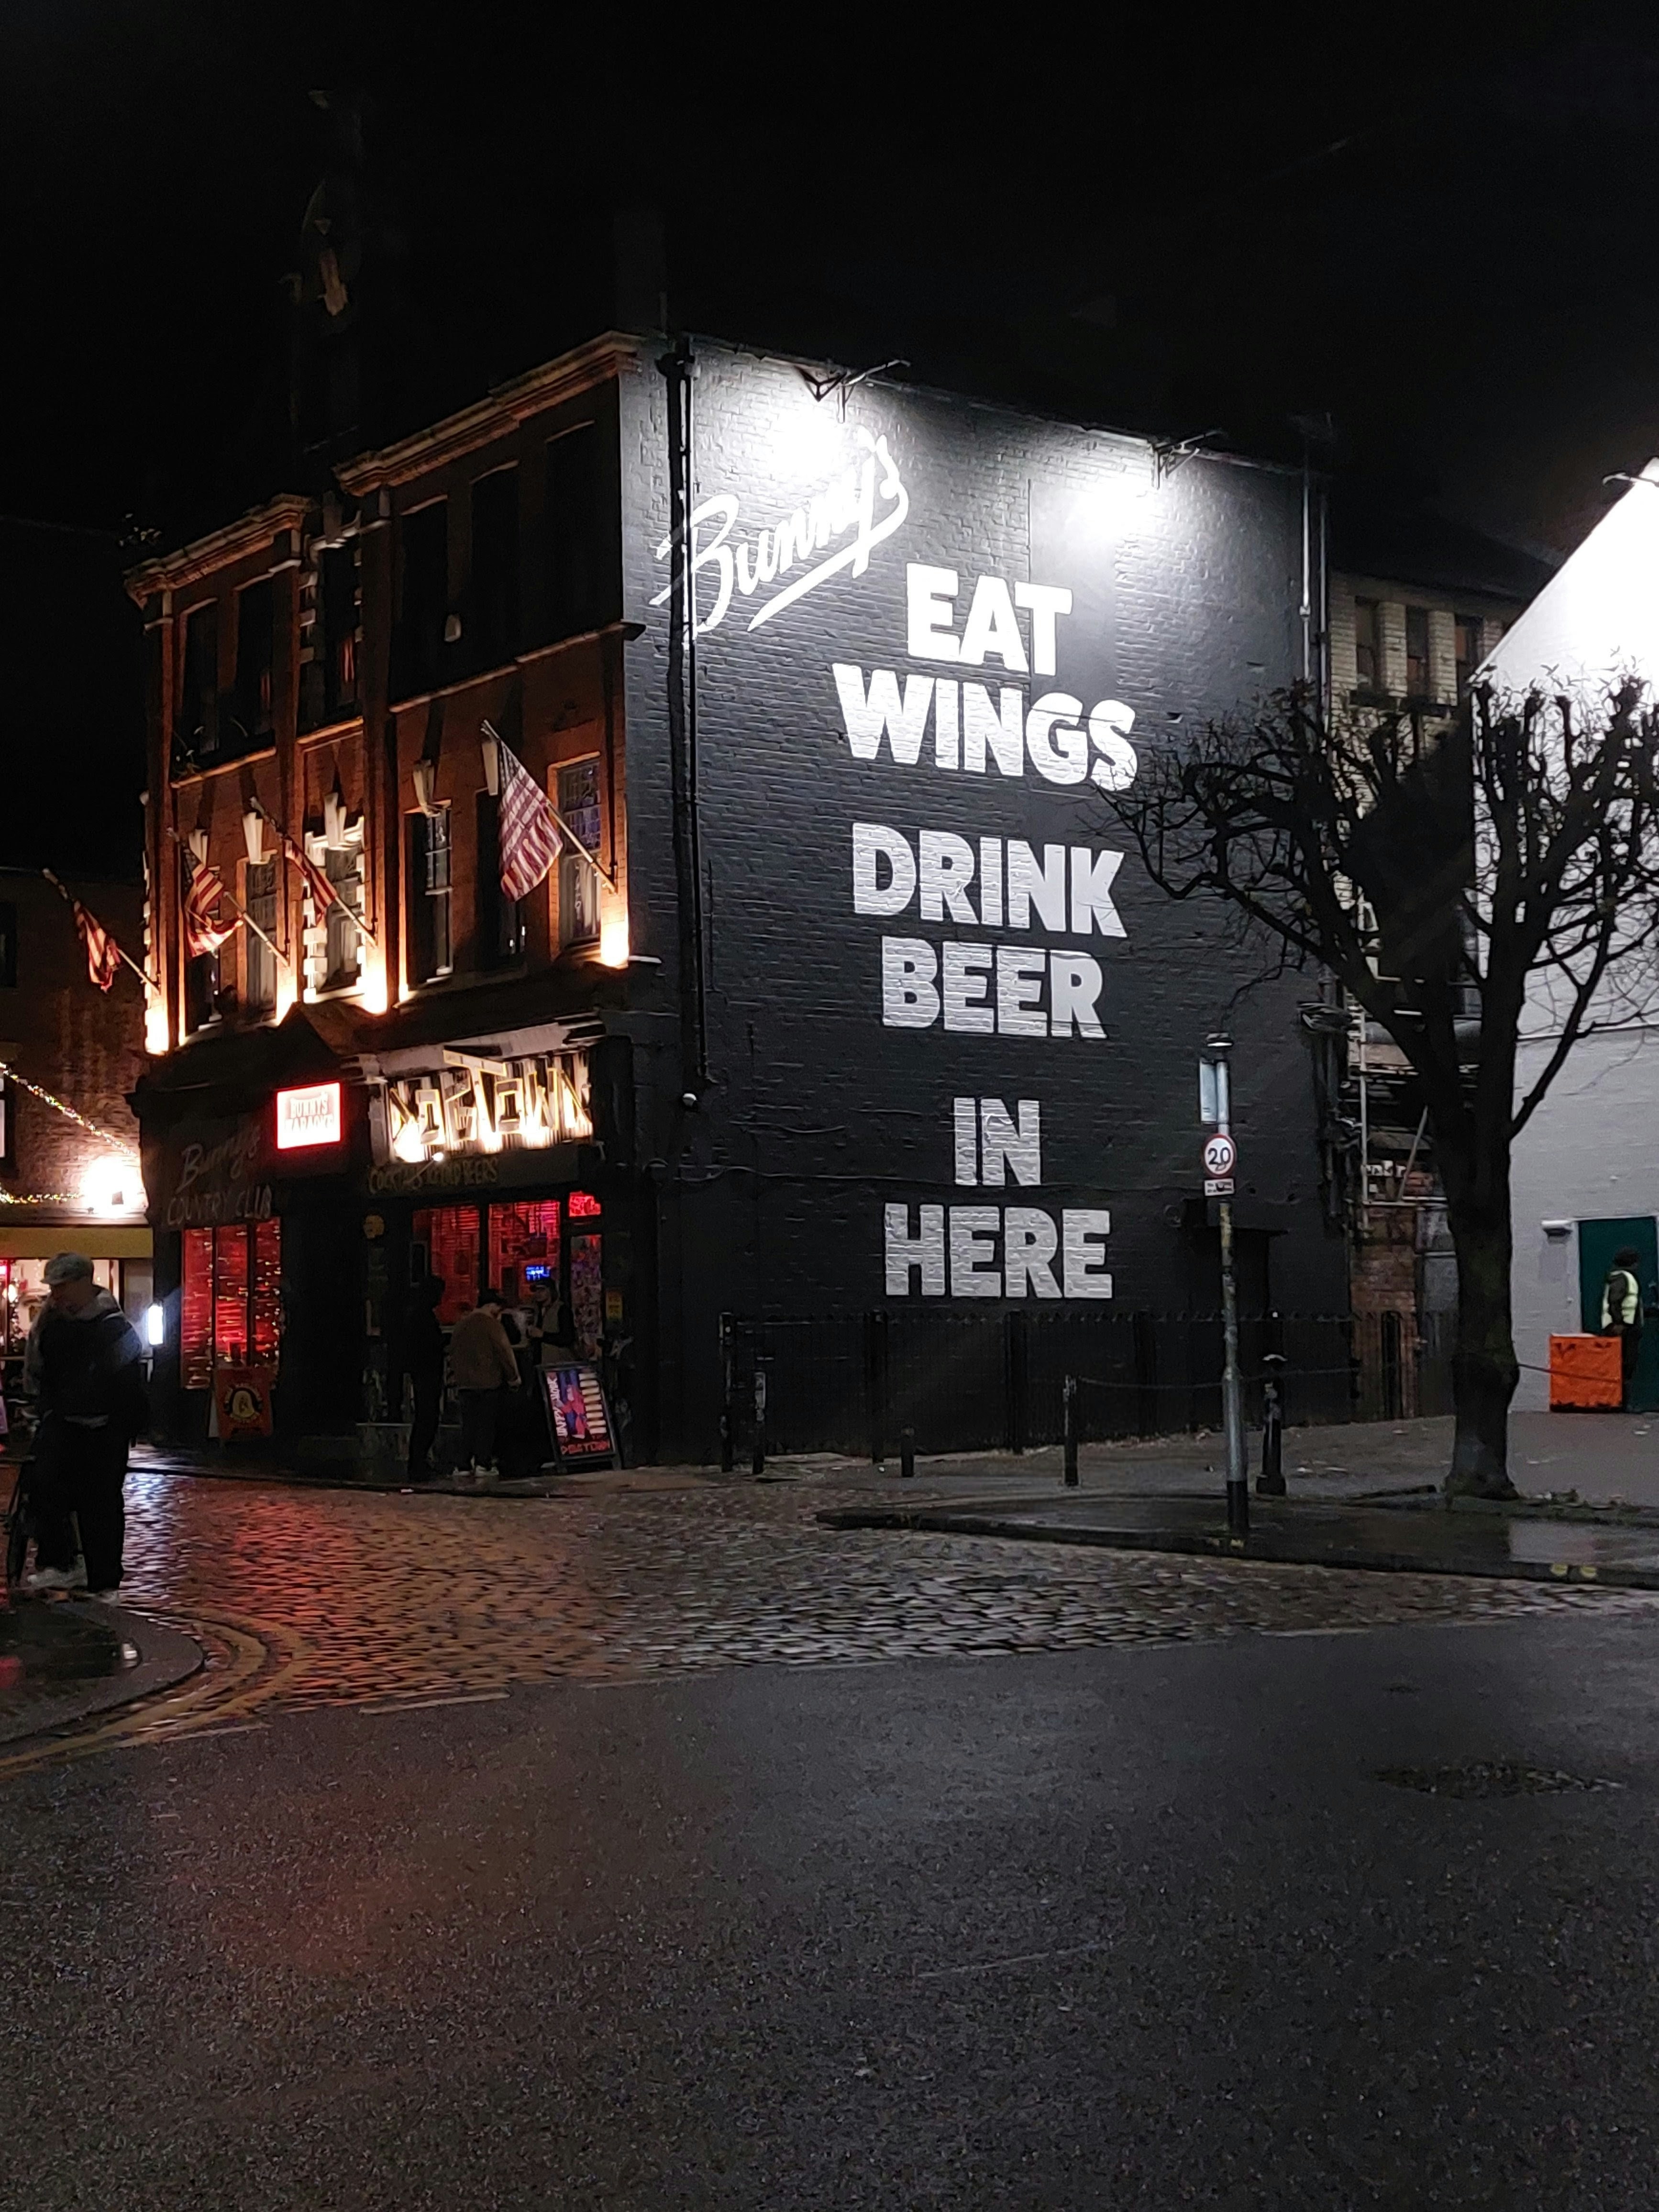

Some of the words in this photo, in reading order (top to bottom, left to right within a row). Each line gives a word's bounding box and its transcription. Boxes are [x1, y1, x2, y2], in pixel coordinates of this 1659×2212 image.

[649, 425, 908, 632] Bunny's
[907, 563, 1073, 676] EAT
[832, 663, 1138, 791] WINGS
[853, 822, 1128, 938] DRINK
[882, 936, 1107, 1039] BEER
[954, 1097, 1041, 1186] IN
[1207, 1147, 1231, 1165] 20
[885, 1202, 1112, 1299] HERE
